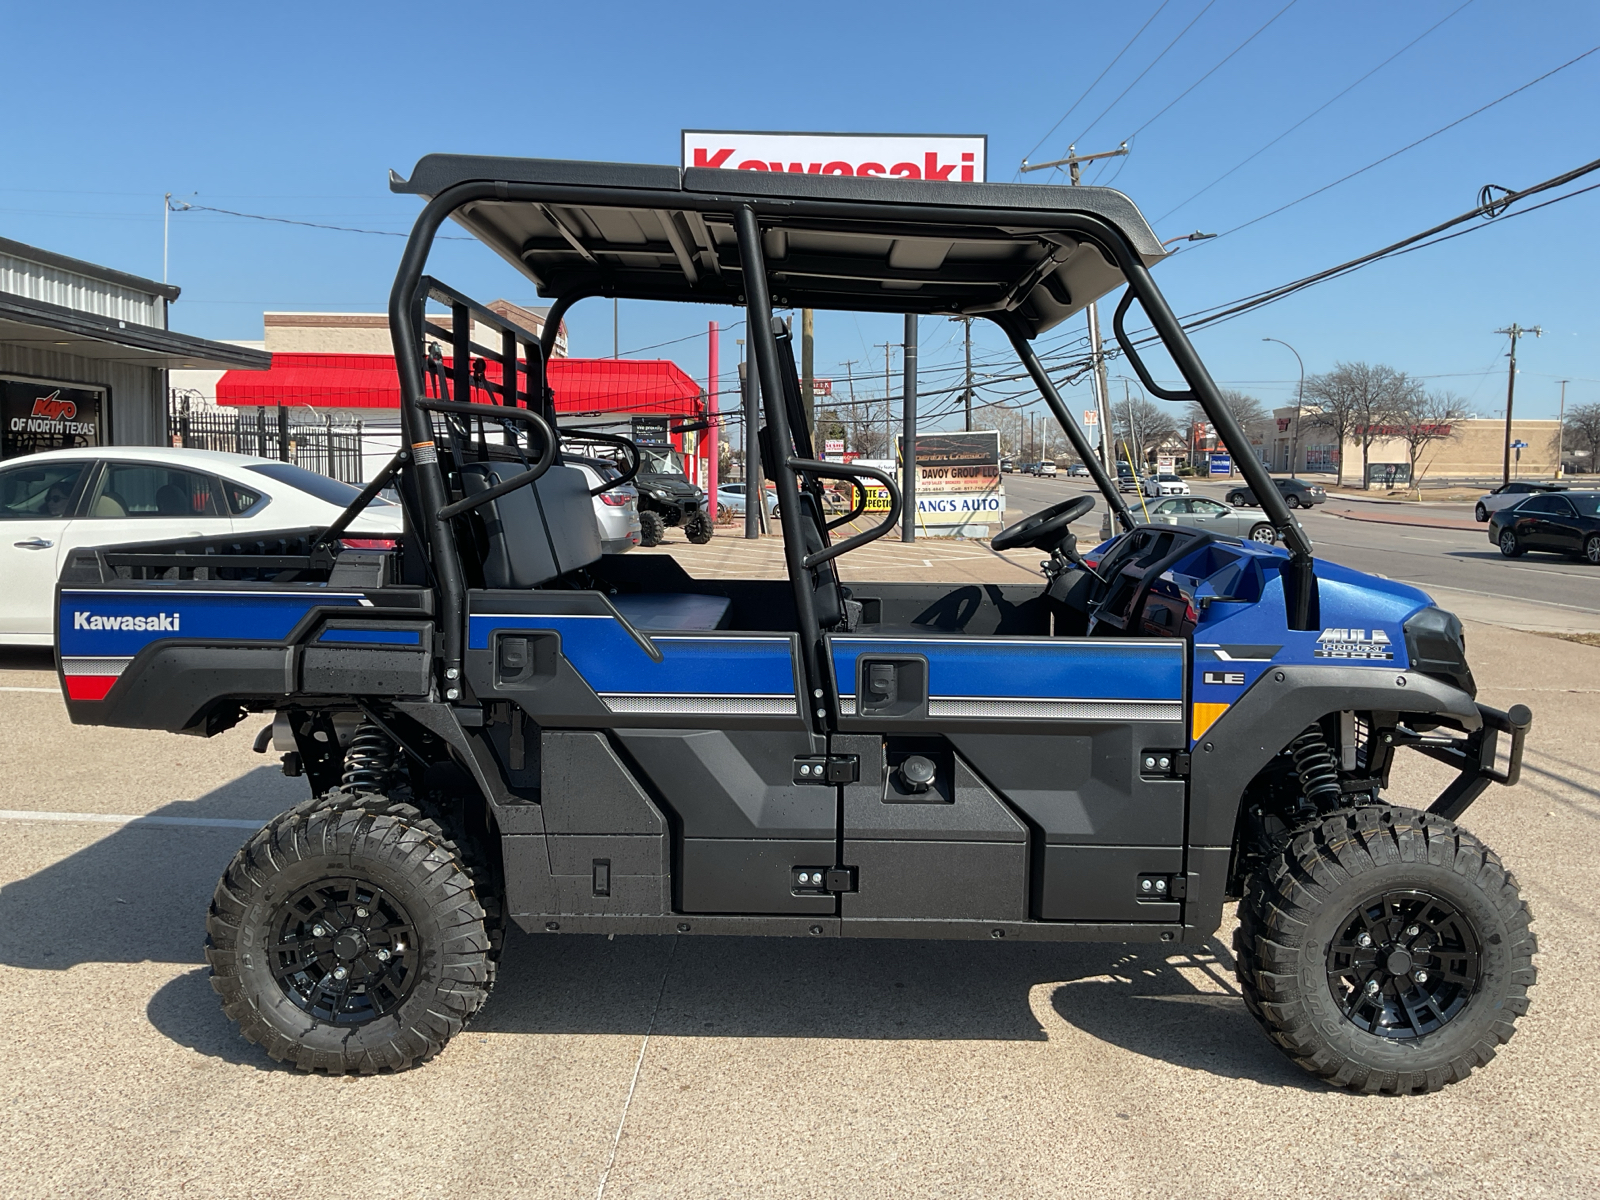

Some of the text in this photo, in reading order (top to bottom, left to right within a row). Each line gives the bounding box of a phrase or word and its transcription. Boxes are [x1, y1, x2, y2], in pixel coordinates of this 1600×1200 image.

[693, 148, 974, 182] Kaki
[31, 389, 77, 420] KAYO
[11, 418, 95, 435] OF NORTH TEXAS
[922, 467, 999, 479] DAVOY GROUP LLC
[855, 489, 877, 498] STE
[855, 499, 892, 508] IPECTIO
[916, 498, 999, 512] ANG'S AUTO
[74, 611, 180, 631] Kawasaki
[1316, 628, 1392, 645] MULE
[1322, 650, 1386, 660] 1000
[1204, 672, 1245, 685] LE
[241, 883, 277, 971] DURO
[1302, 938, 1343, 1037] DURO
